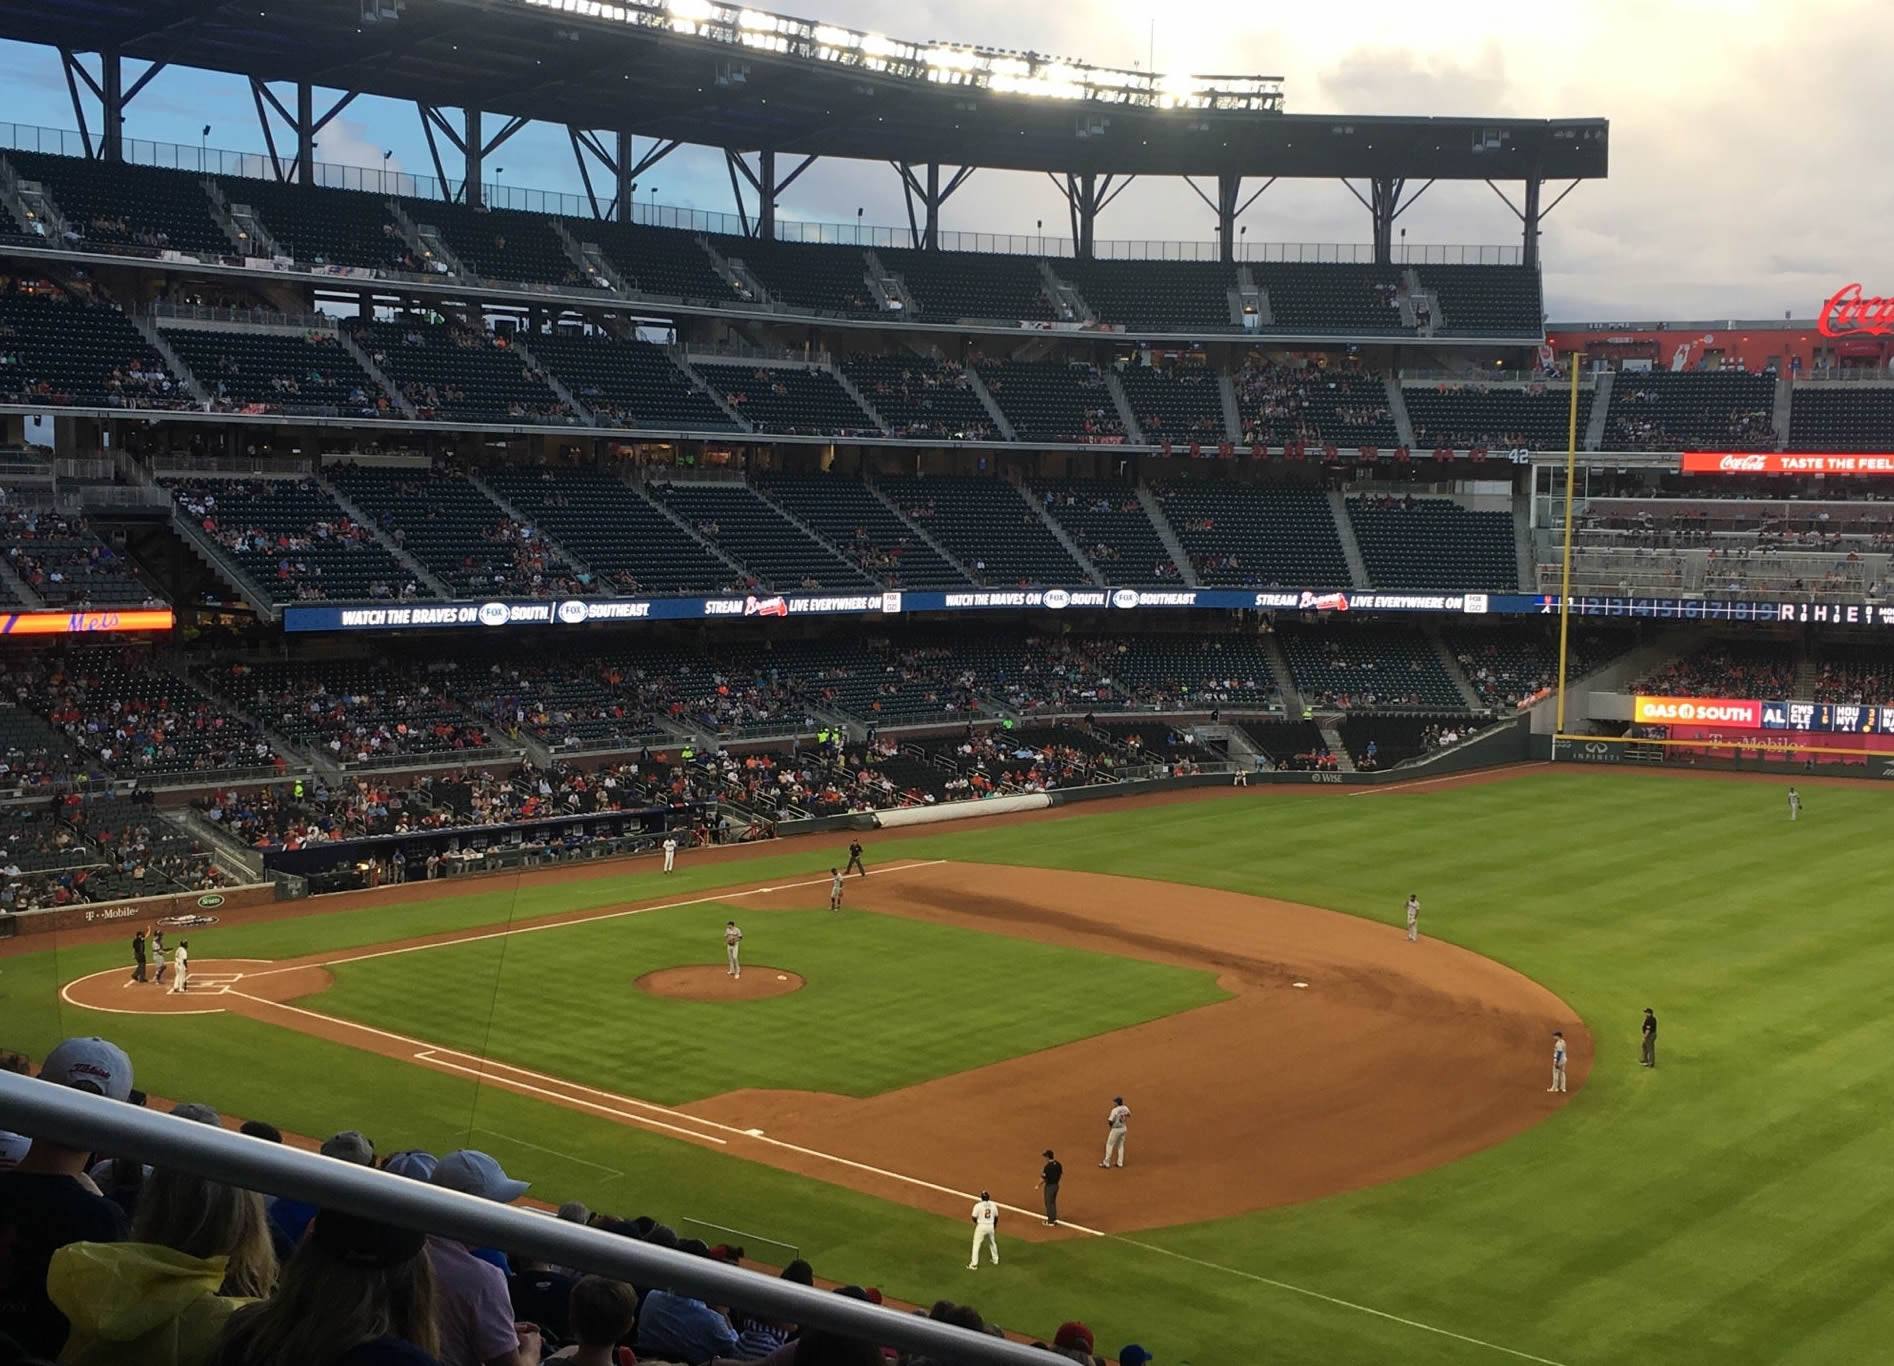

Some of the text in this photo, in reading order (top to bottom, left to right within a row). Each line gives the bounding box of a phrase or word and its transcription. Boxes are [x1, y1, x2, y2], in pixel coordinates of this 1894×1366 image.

[1508, 448, 1528, 464] 42
[1781, 457, 1824, 469] TASTE
[1828, 457, 1855, 469] THE
[945, 591, 1196, 607] WATCH THE BRAVES ON FOX SOUTH FOX SOUTHEAST
[1255, 594, 1298, 606] STREAM
[1350, 596, 1373, 608] LIVE
[1374, 596, 1444, 609] EVERYWHERE
[1445, 597, 1463, 609] ON
[705, 600, 743, 615] STREAM
[789, 599, 808, 612] LIVE
[809, 597, 867, 611] EVERYWHERE
[868, 597, 881, 610] ON
[1588, 599, 1599, 615] 2
[1612, 599, 1623, 615] 3
[1635, 599, 1649, 616] 4
[1661, 600, 1672, 617] 5
[1685, 601, 1697, 618] 6
[1711, 602, 1722, 618] 7
[1735, 602, 1747, 619] 8
[1760, 603, 1772, 620] 9
[1781, 604, 1795, 620] R
[1814, 605, 1827, 621] H
[1847, 606, 1859, 622] E
[1801, 603, 1807, 612] 1
[1834, 605, 1840, 614] 1
[342, 603, 650, 626] WATCH THE BRAVES ON FOX SOUTH FOX SOUTHEAST
[1866, 615, 1872, 624] 1
[1643, 703, 1752, 721] GAS SOUTH
[1790, 704, 1828, 715] CWS 1
[1836, 706, 1876, 717] HOU 3
[1763, 709, 1785, 724] AL
[1790, 714, 1811, 723] CLE
[1868, 717, 1875, 726] 2
[1572, 752, 1620, 761] INFINITI
[1322, 773, 1343, 783] WISE
[985, 1208, 991, 1219] 2
